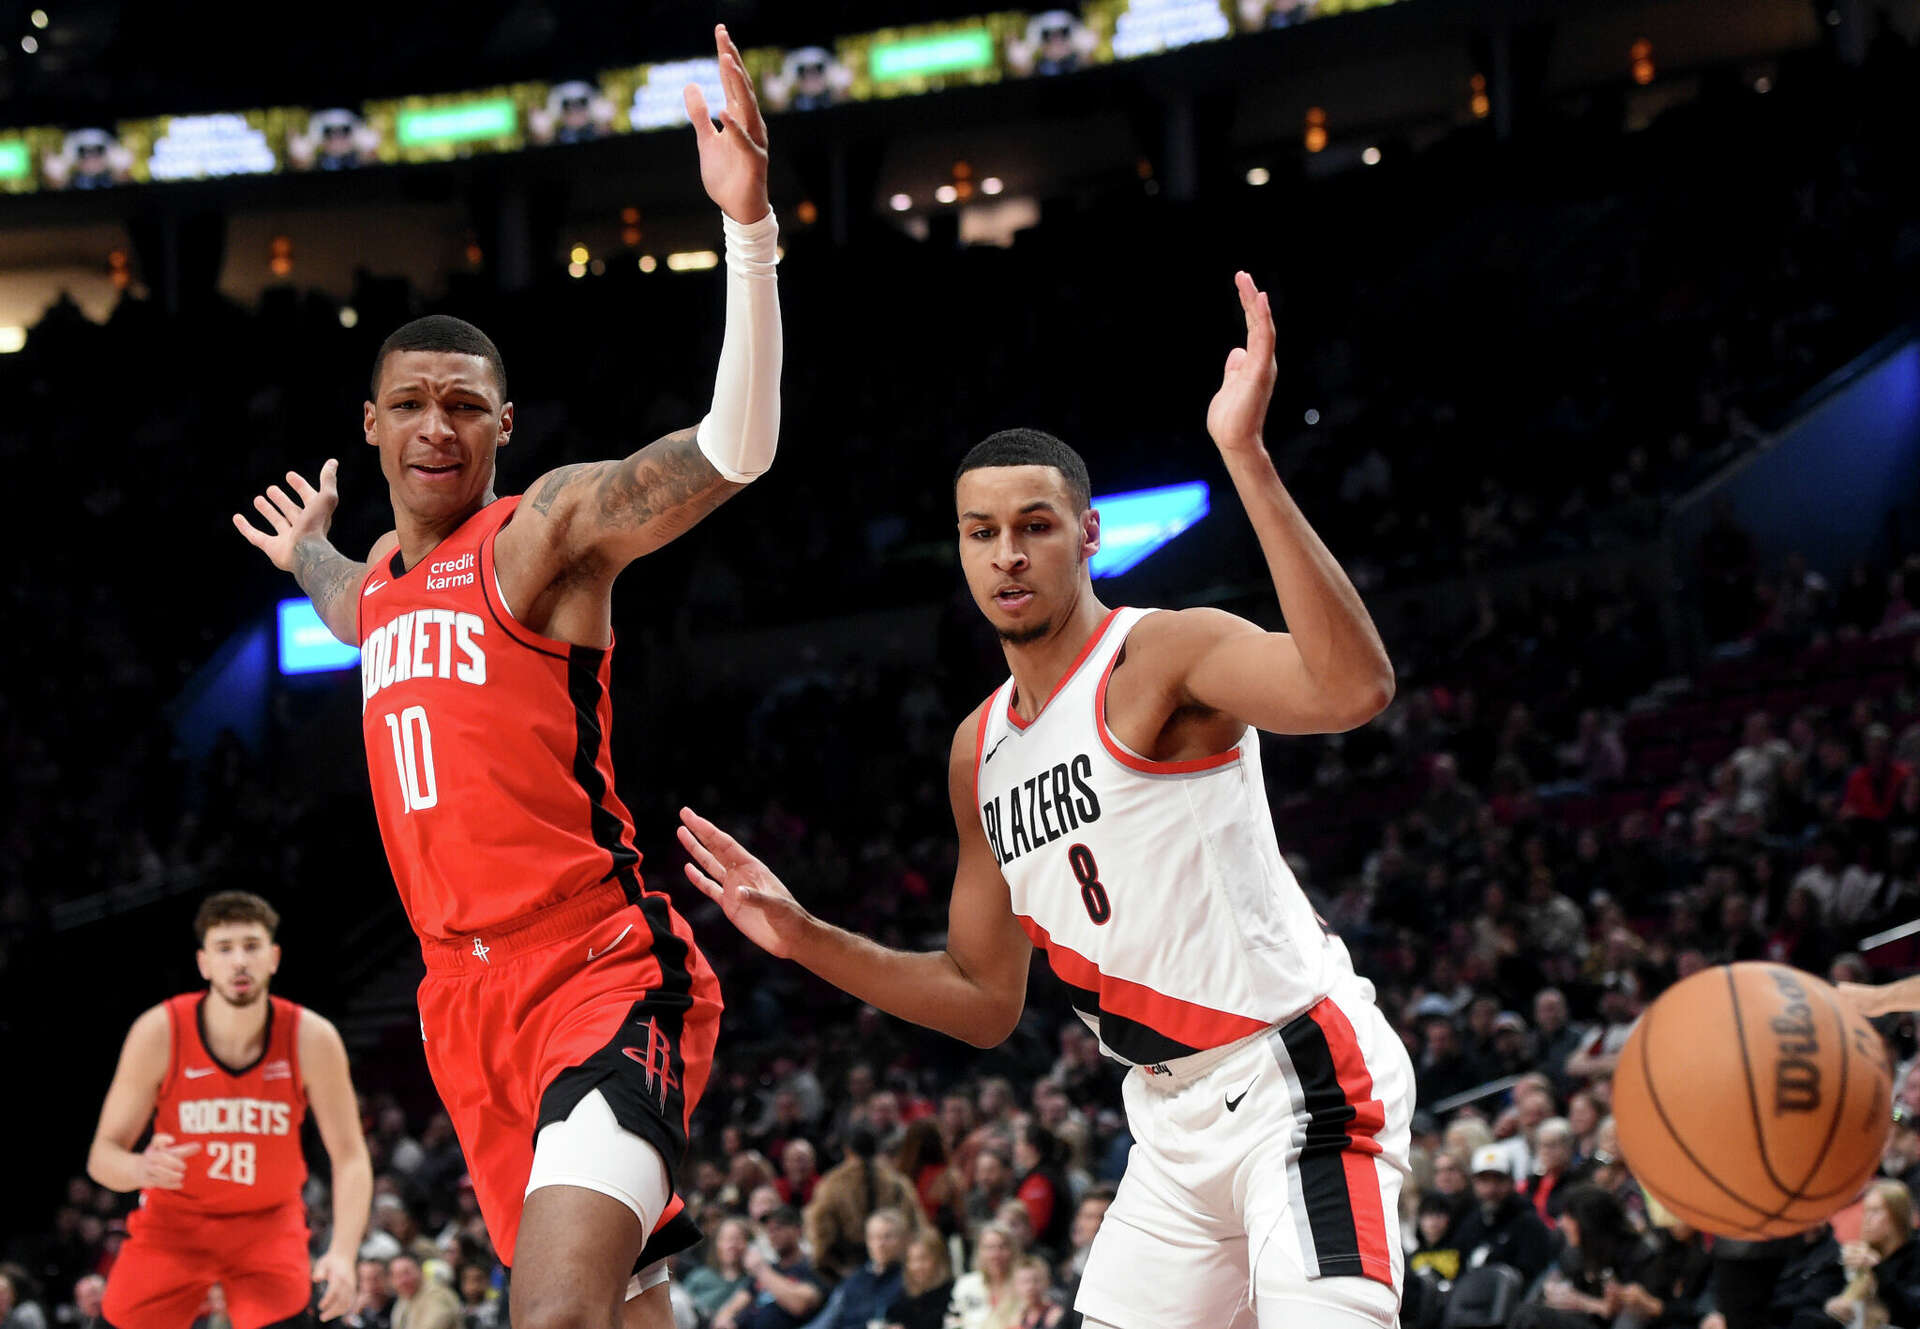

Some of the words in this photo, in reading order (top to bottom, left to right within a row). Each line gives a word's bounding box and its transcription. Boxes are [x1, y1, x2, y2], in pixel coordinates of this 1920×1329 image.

[426, 571, 475, 591] karma
[430, 553, 475, 575] credit
[384, 704, 438, 814] 10
[983, 753, 1101, 868] BLAZERS
[1068, 842, 1112, 926] 8
[178, 1097, 291, 1136] ROCKETS
[206, 1140, 257, 1187] 28
